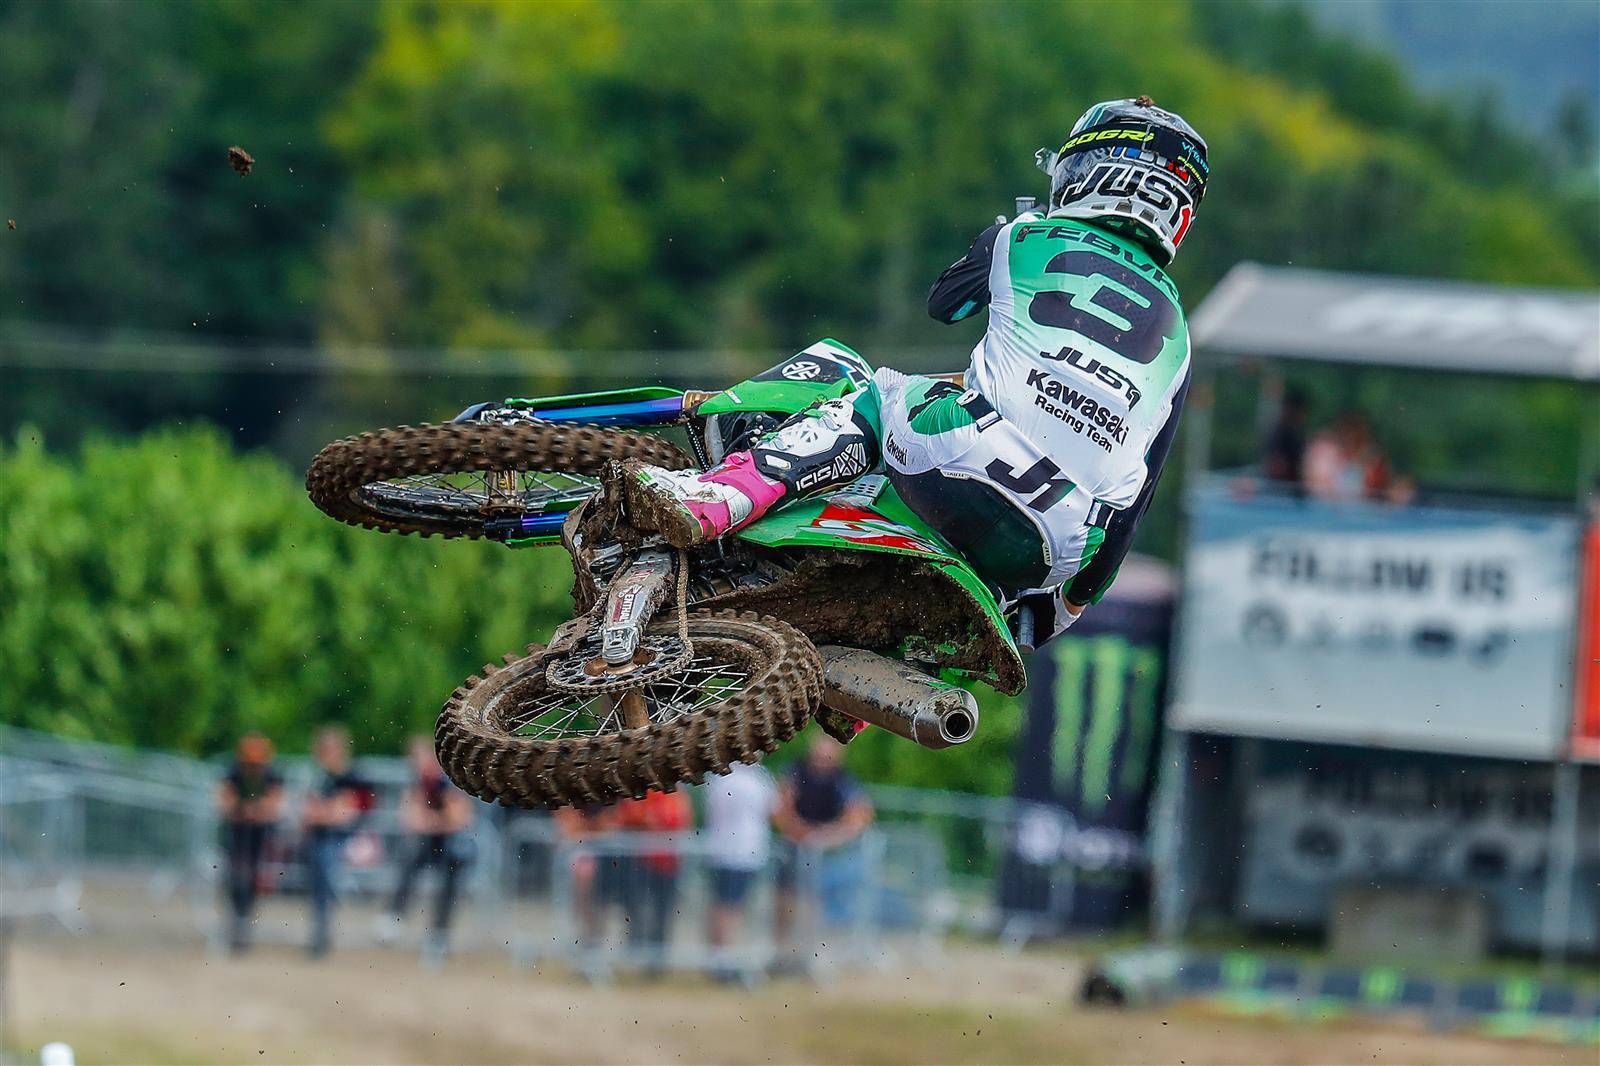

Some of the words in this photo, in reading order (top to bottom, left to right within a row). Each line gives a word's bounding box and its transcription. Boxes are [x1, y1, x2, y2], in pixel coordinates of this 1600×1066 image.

[1015, 225, 1179, 301] FEBVR
[1028, 250, 1180, 365] 3
[1026, 368, 1130, 447] Kawasaki
[1034, 394, 1086, 434] Racing
[1086, 423, 1114, 454] Team
